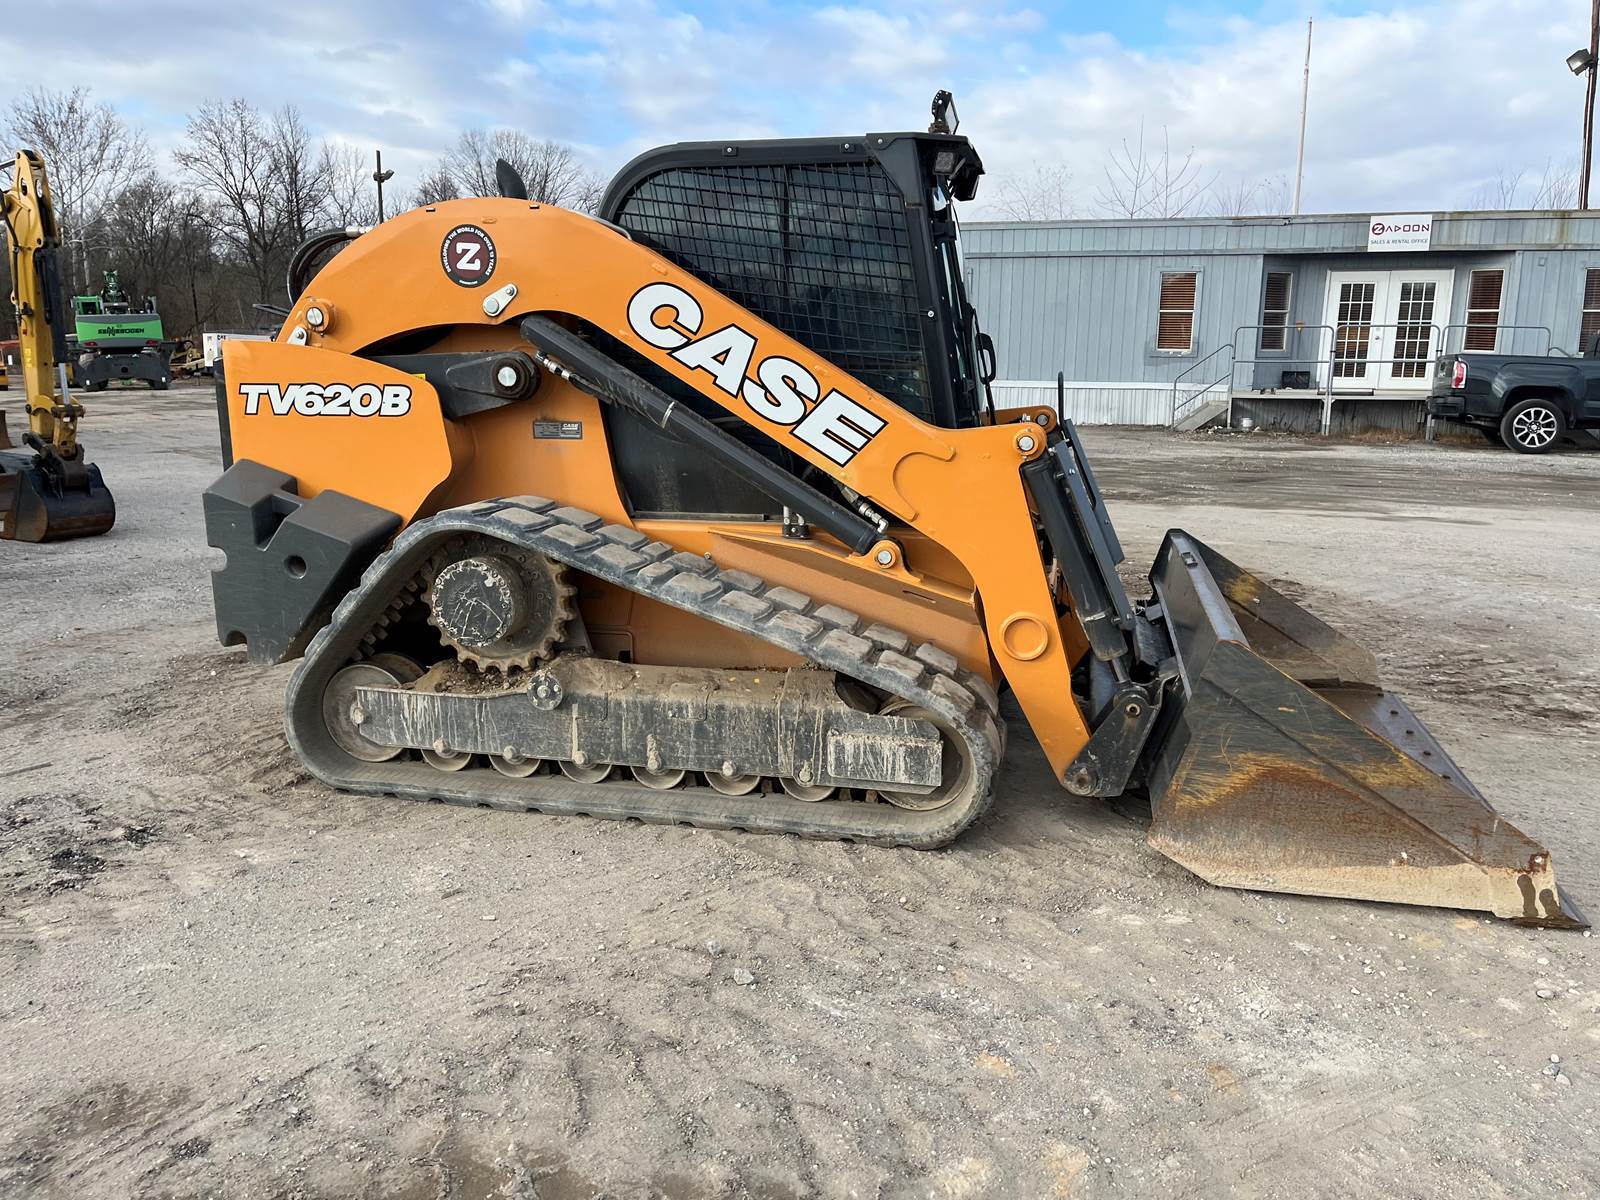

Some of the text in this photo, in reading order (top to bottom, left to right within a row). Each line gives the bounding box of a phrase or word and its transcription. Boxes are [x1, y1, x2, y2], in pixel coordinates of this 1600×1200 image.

[448, 230, 458, 240] THE
[474, 229, 484, 238] FOR
[484, 236, 493, 250] OVER
[456, 242, 480, 270] Z
[485, 258, 494, 276] YEARS
[626, 282, 889, 468] CASE
[239, 383, 412, 417] TV620B
